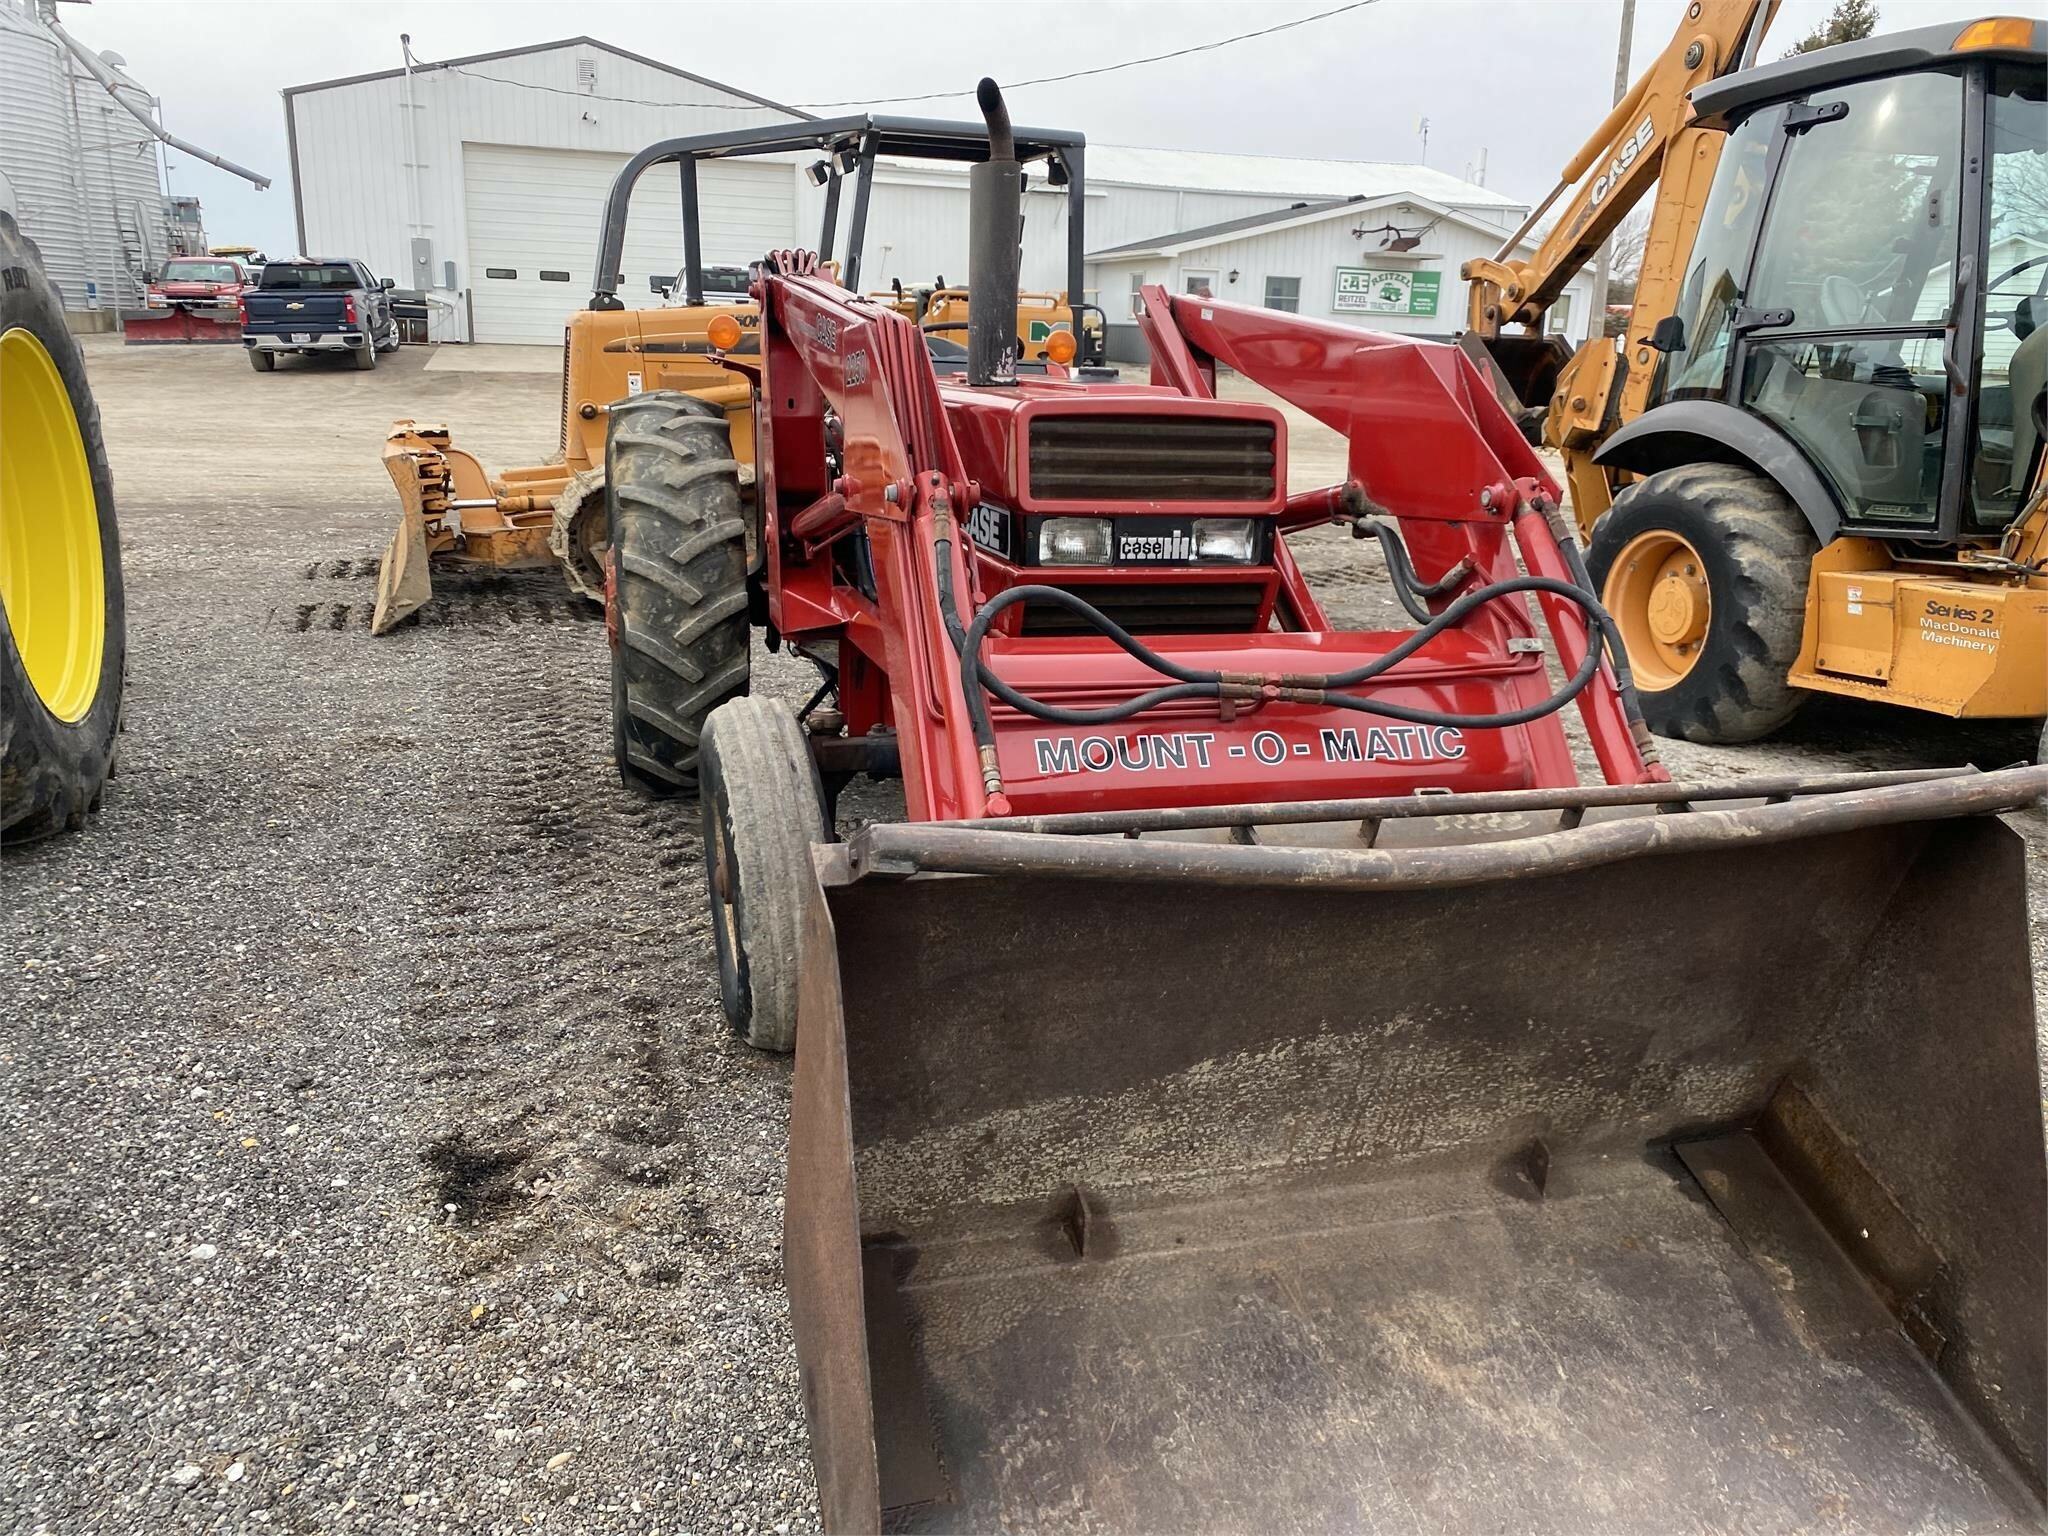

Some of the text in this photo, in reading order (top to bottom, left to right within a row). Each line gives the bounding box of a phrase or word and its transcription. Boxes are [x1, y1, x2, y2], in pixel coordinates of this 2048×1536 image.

[1591, 113, 1655, 206] CASE
[1371, 273, 1411, 288] REITZEL
[1338, 295, 1367, 304] REITZEL
[815, 312, 837, 352] CASE
[1926, 600, 1995, 624] Series 2
[1920, 617, 2000, 640] MacDonald
[1921, 630, 1996, 655] Machinery
[1035, 733, 1215, 773] MOUNT
[1319, 725, 1466, 763] MATIC
